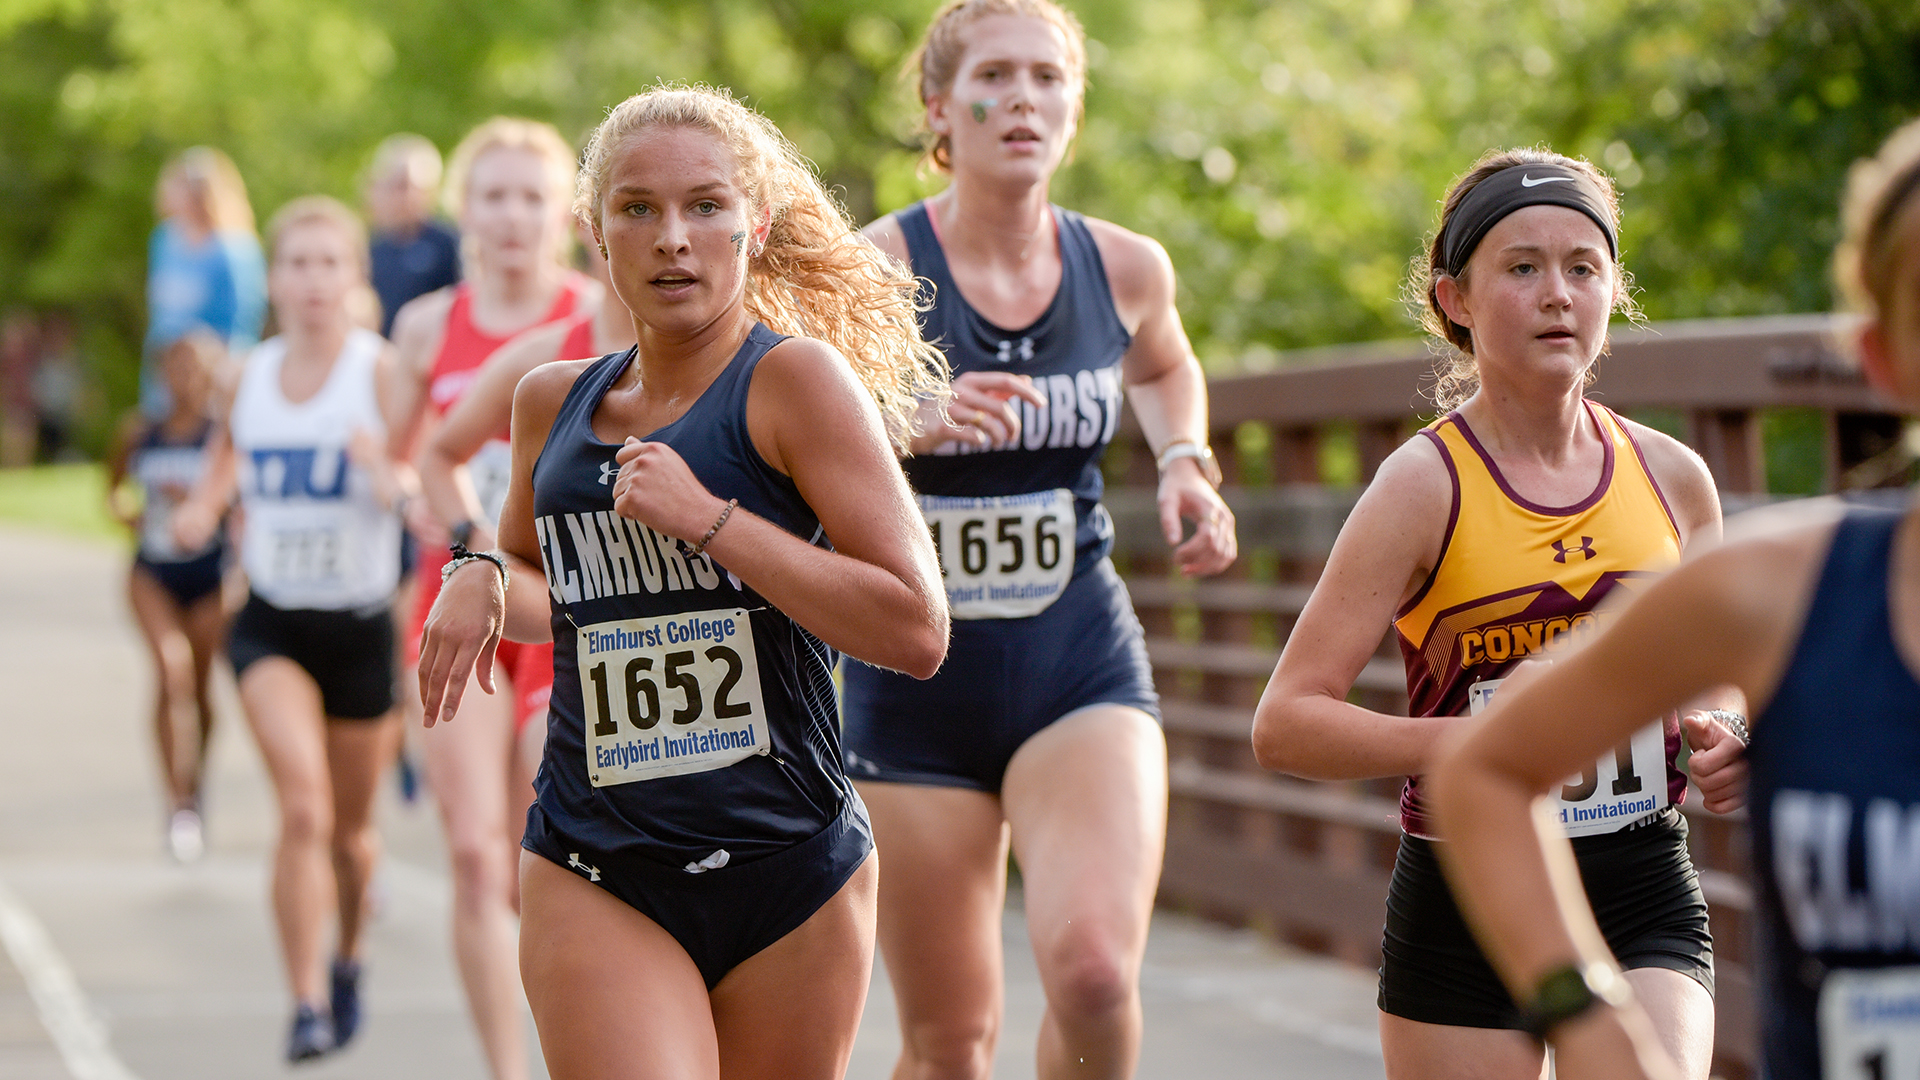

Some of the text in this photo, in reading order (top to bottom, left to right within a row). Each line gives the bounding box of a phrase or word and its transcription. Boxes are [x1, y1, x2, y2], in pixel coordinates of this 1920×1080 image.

[535, 510, 742, 605] ELMHURS
[588, 617, 736, 654] Elmhurst College
[1459, 609, 1615, 670] CONCO
[590, 645, 752, 737] 1652
[595, 738, 660, 770] Earlybird
[664, 724, 756, 758] Invitational
[1573, 795, 1656, 822] Invitational
